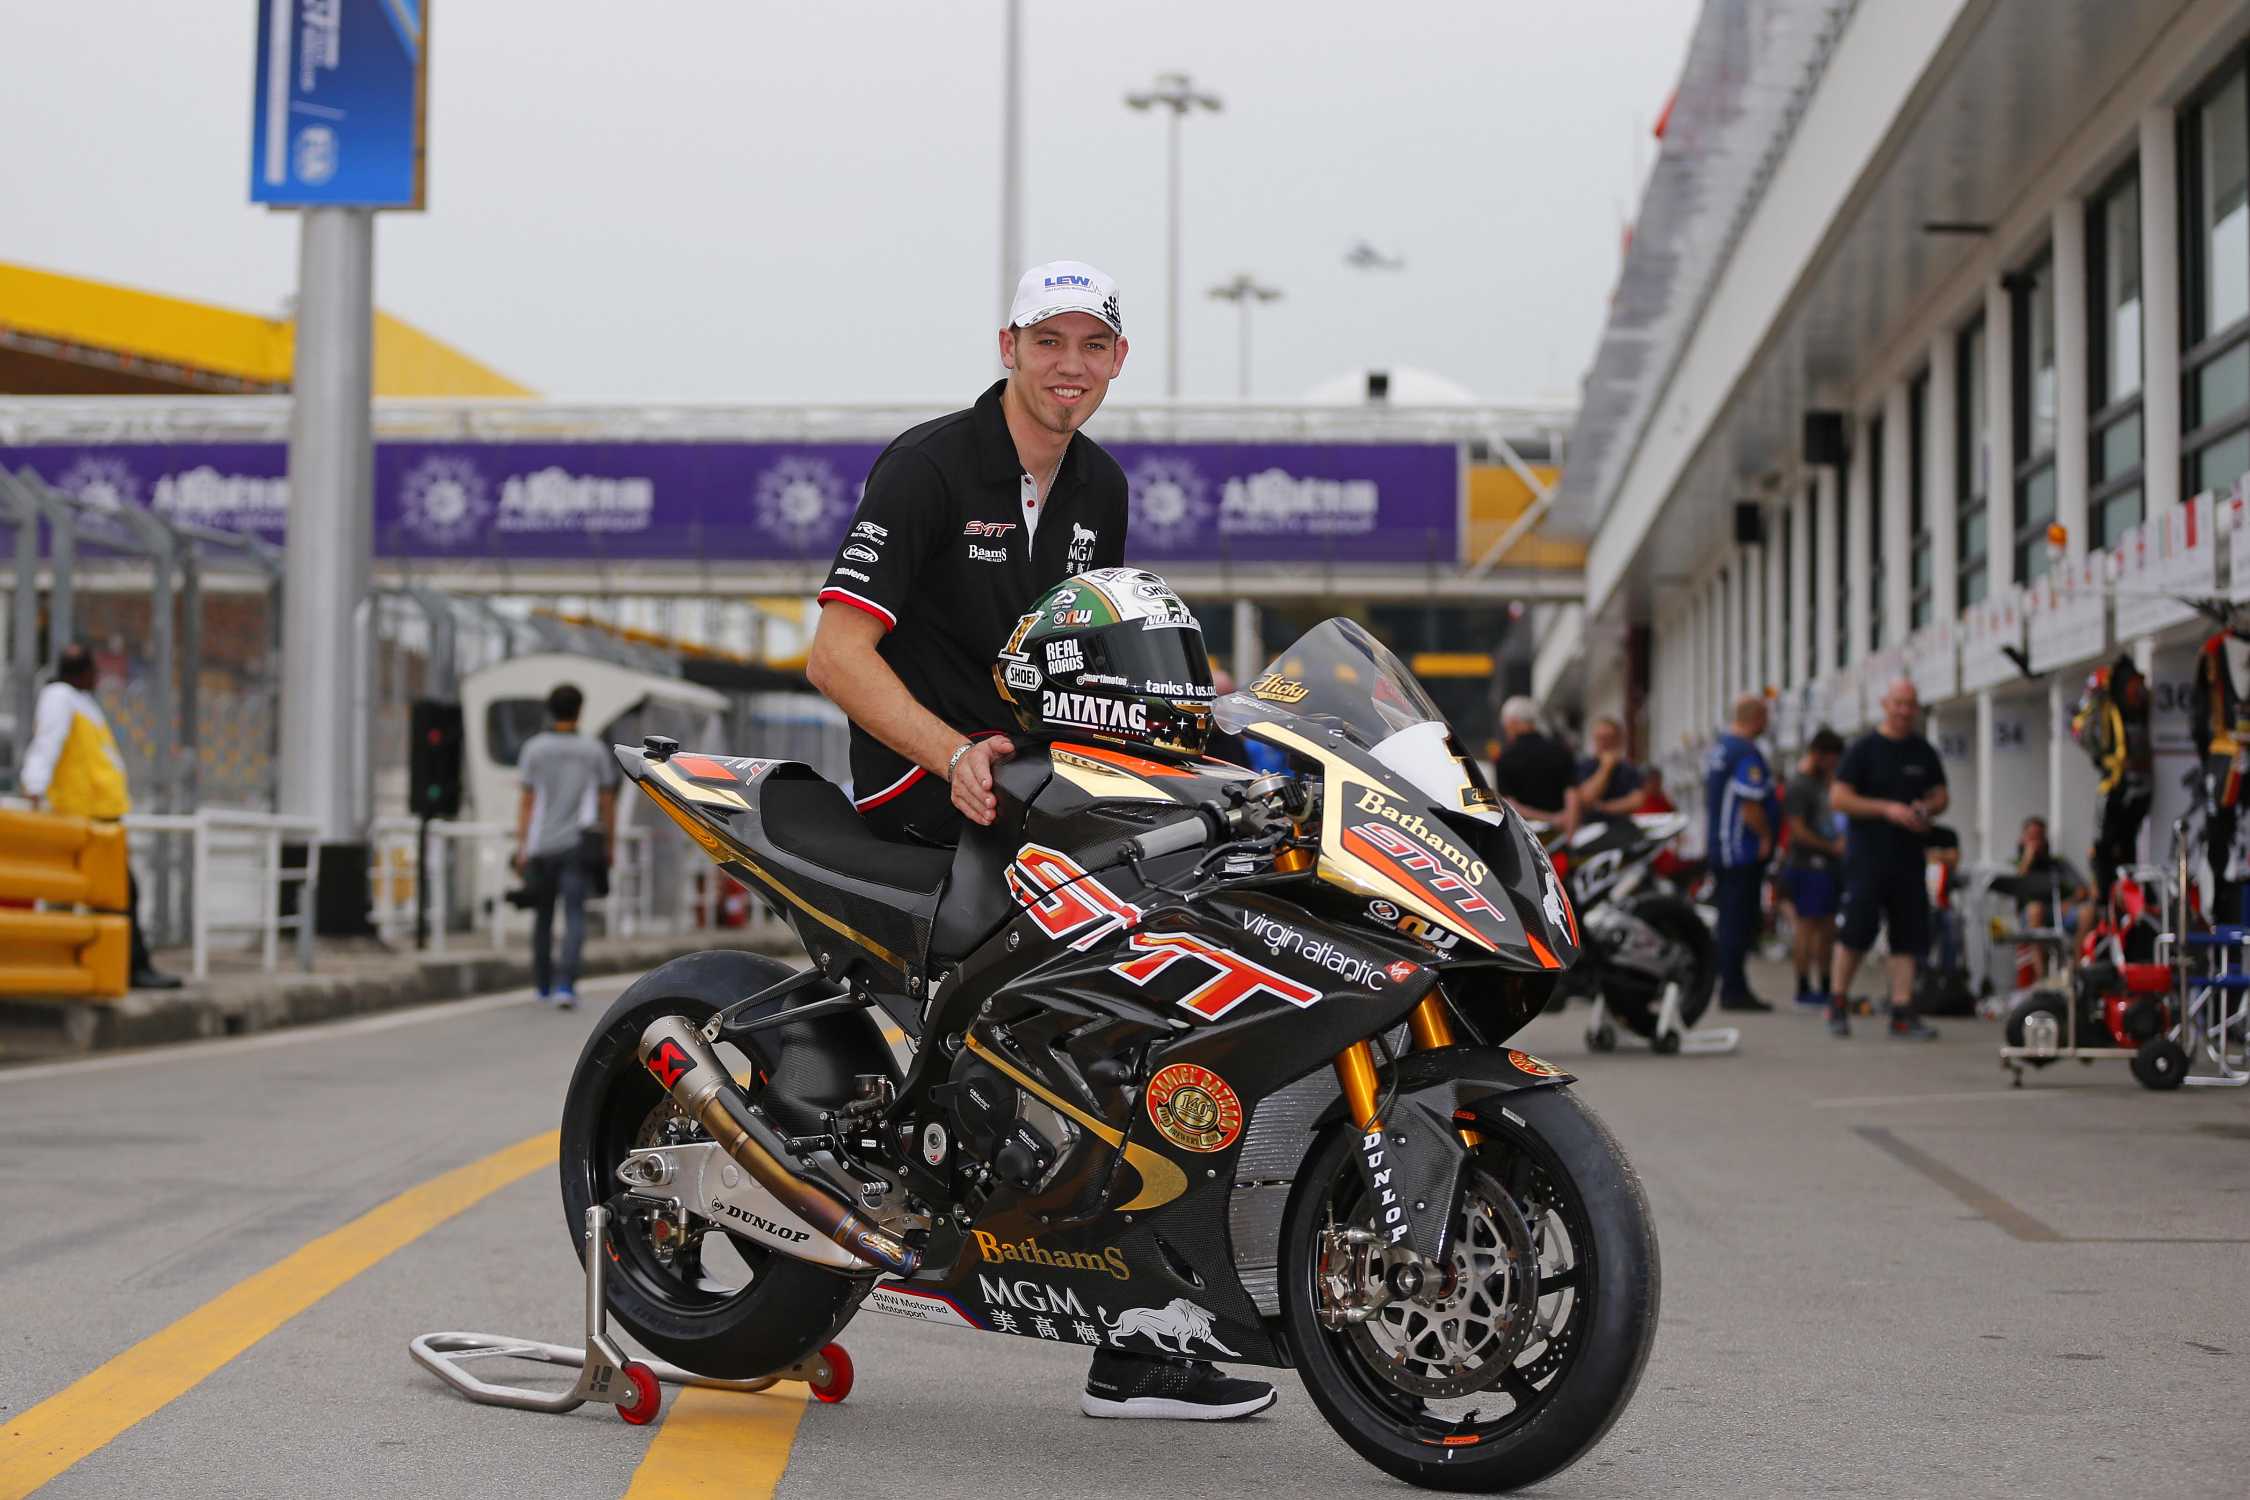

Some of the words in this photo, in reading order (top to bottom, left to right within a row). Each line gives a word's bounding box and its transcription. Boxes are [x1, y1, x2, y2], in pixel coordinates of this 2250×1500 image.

[1045, 276, 1090, 287] LEW
[1045, 638, 1083, 661] REAL
[1009, 667, 1036, 686] SHOEI
[1047, 655, 1085, 676] ROADS
[1146, 679, 1184, 696] tanks
[1186, 683, 1195, 697] R
[1043, 690, 1148, 731] DATATAG
[1362, 1132, 1408, 1243] DUNLOP
[726, 1205, 810, 1243] DUNLOP
[871, 1292, 899, 1305] BMW
[899, 1297, 948, 1314] Motorrad
[978, 1273, 1090, 1318] MGM
[876, 1302, 928, 1319] Motorsport
[990, 1308, 1103, 1346] 美高梅
